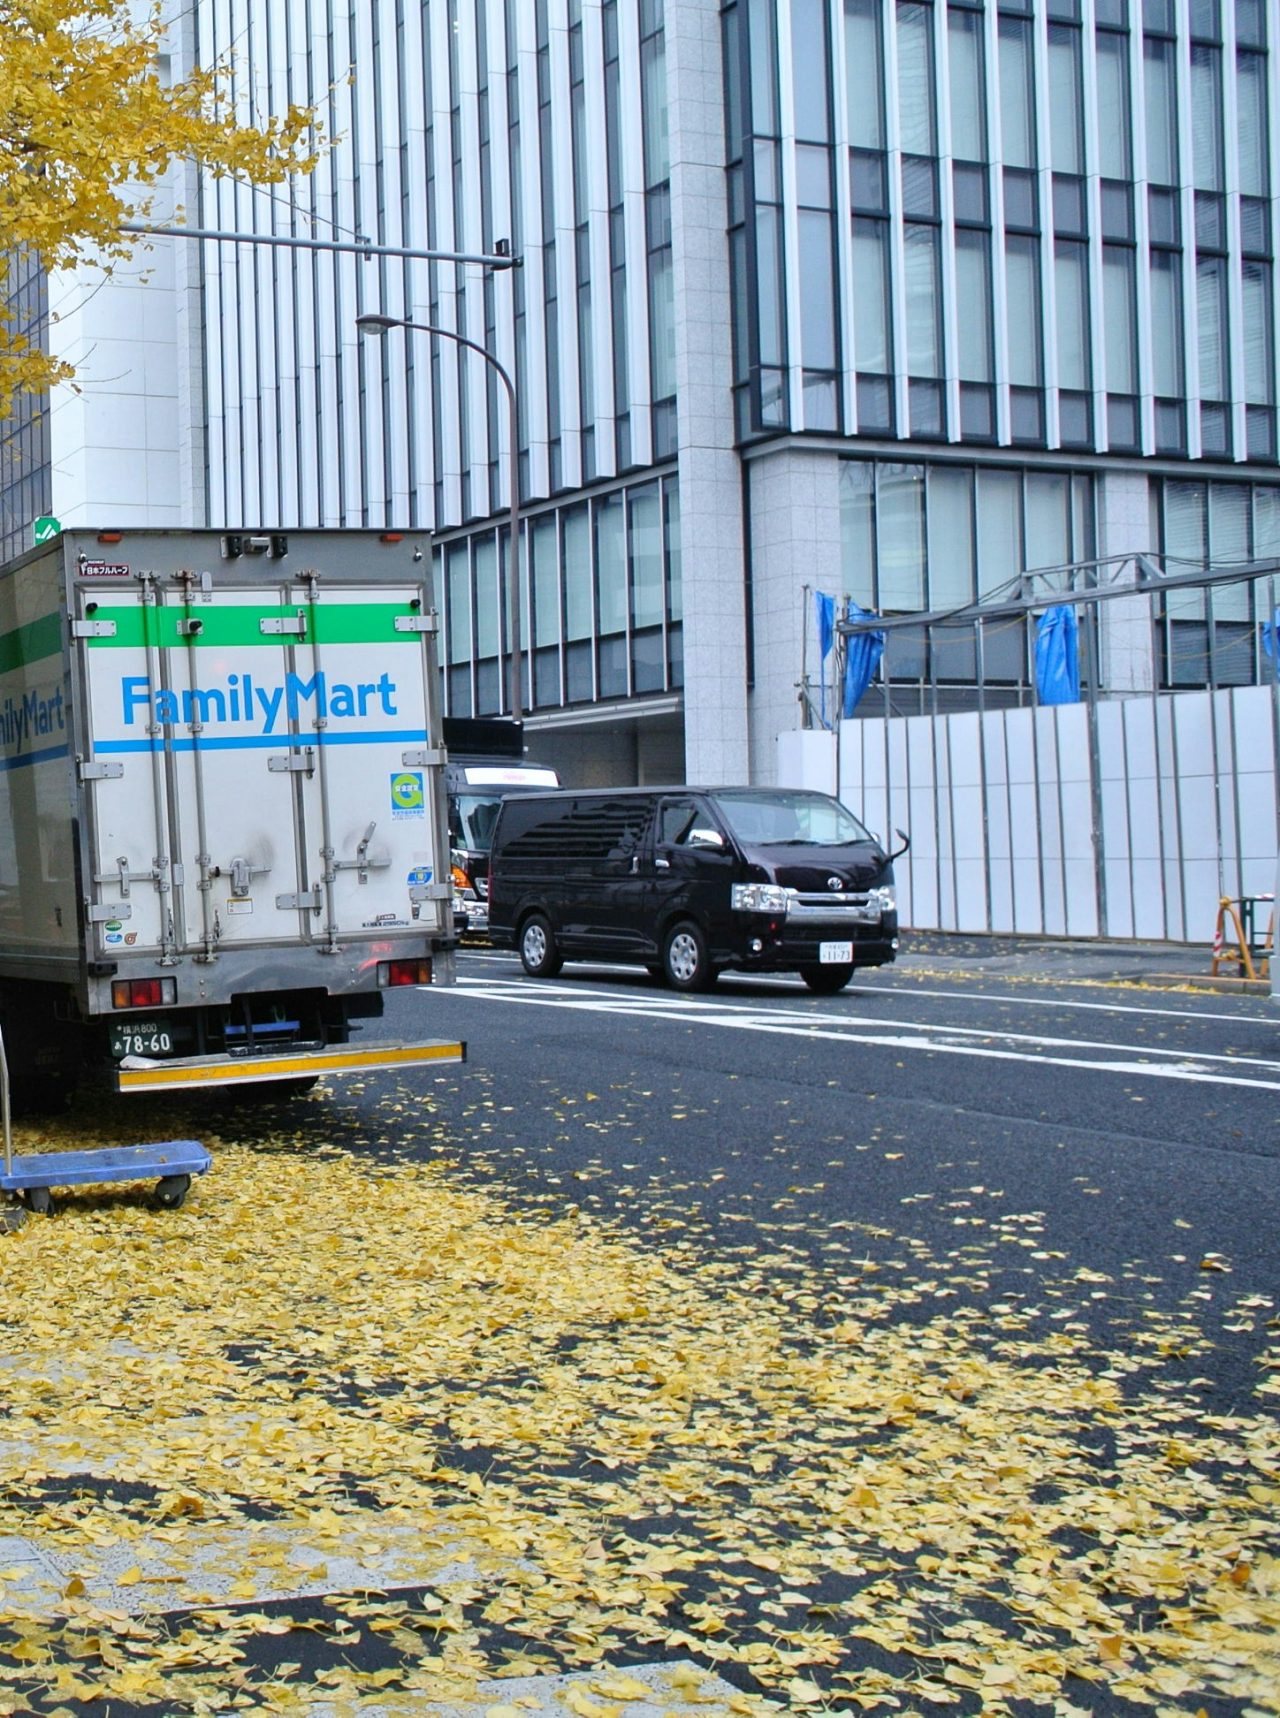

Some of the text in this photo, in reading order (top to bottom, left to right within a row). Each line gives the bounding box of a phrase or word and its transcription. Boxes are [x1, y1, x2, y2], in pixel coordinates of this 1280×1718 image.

[86, 566, 128, 575] 日本フルハーフ
[121, 671, 398, 734] FamilyMart
[123, 1033, 170, 1054] 78-60
